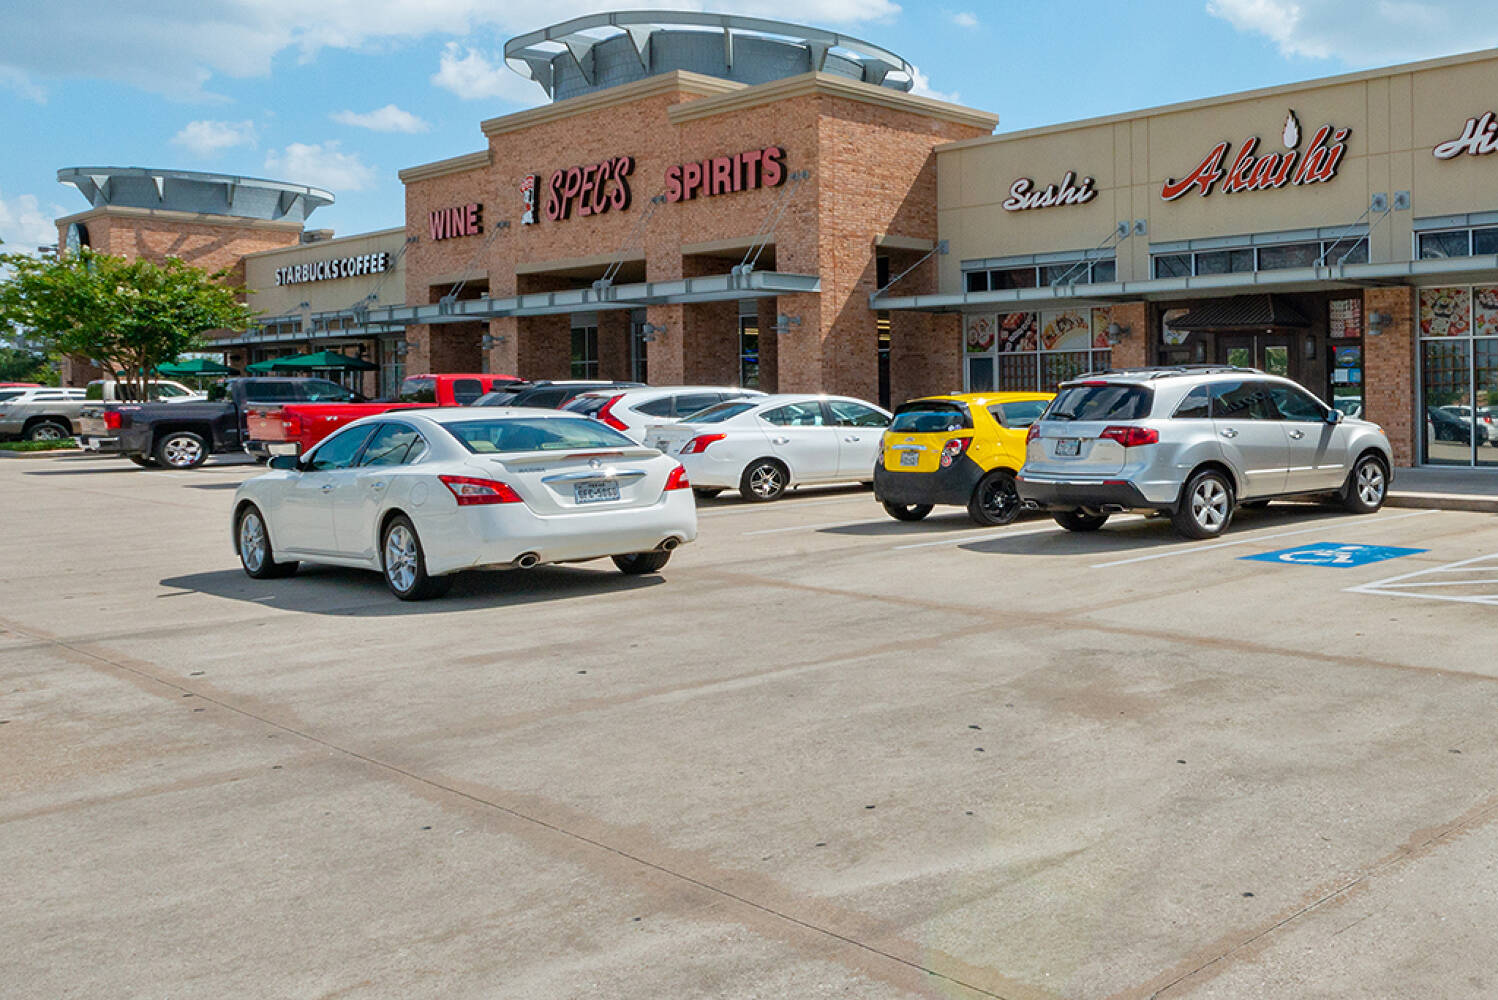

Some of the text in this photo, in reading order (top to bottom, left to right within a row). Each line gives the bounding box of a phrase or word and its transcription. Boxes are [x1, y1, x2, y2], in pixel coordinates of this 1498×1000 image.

[546, 156, 632, 221] SPEC'S
[664, 147, 784, 203] SPIRITS
[1002, 170, 1096, 211] Sushi
[429, 203, 481, 241] WINE
[274, 251, 387, 287] STARBUCKS COFFEE
